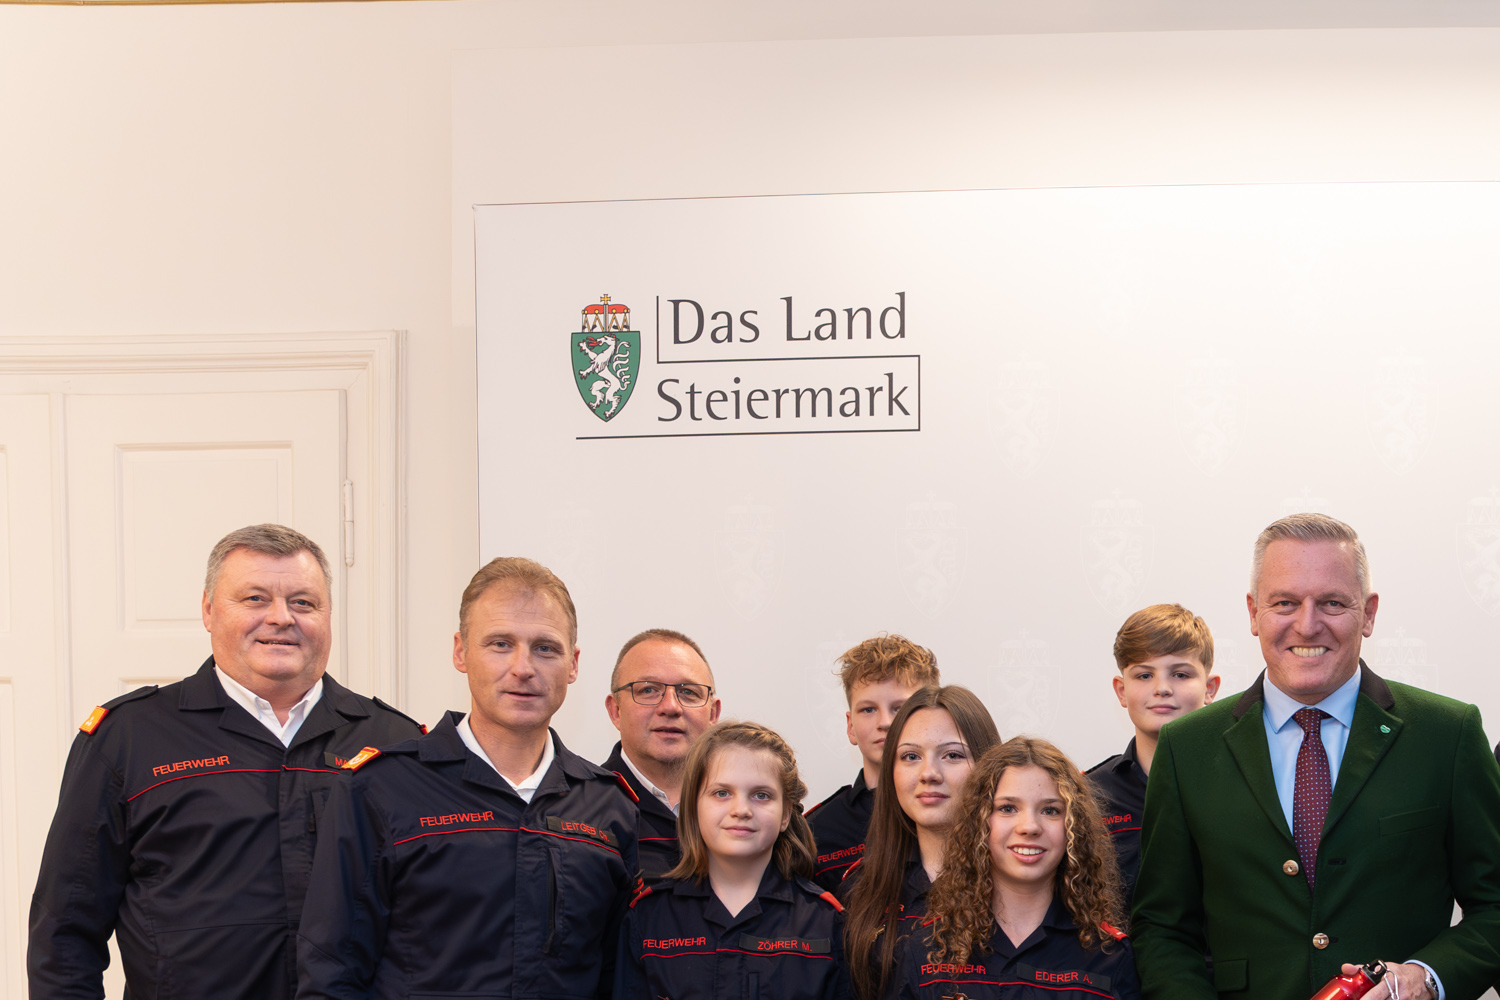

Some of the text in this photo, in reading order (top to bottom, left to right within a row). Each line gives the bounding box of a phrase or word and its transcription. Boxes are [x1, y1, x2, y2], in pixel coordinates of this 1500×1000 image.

[667, 291, 906, 345] Das Land
[657, 372, 911, 422] Steiermark
[153, 756, 229, 776] FEUERWEHR
[420, 811, 494, 827] FEUERWEHR
[561, 822, 597, 835] LEITGEB
[818, 844, 865, 863] FEUERWEHR
[643, 937, 706, 949] FEUERWEHR
[758, 939, 812, 951] ZÖHRER M.
[920, 963, 986, 975] FEUERWEHR
[1036, 971, 1093, 984] EDERER A.
